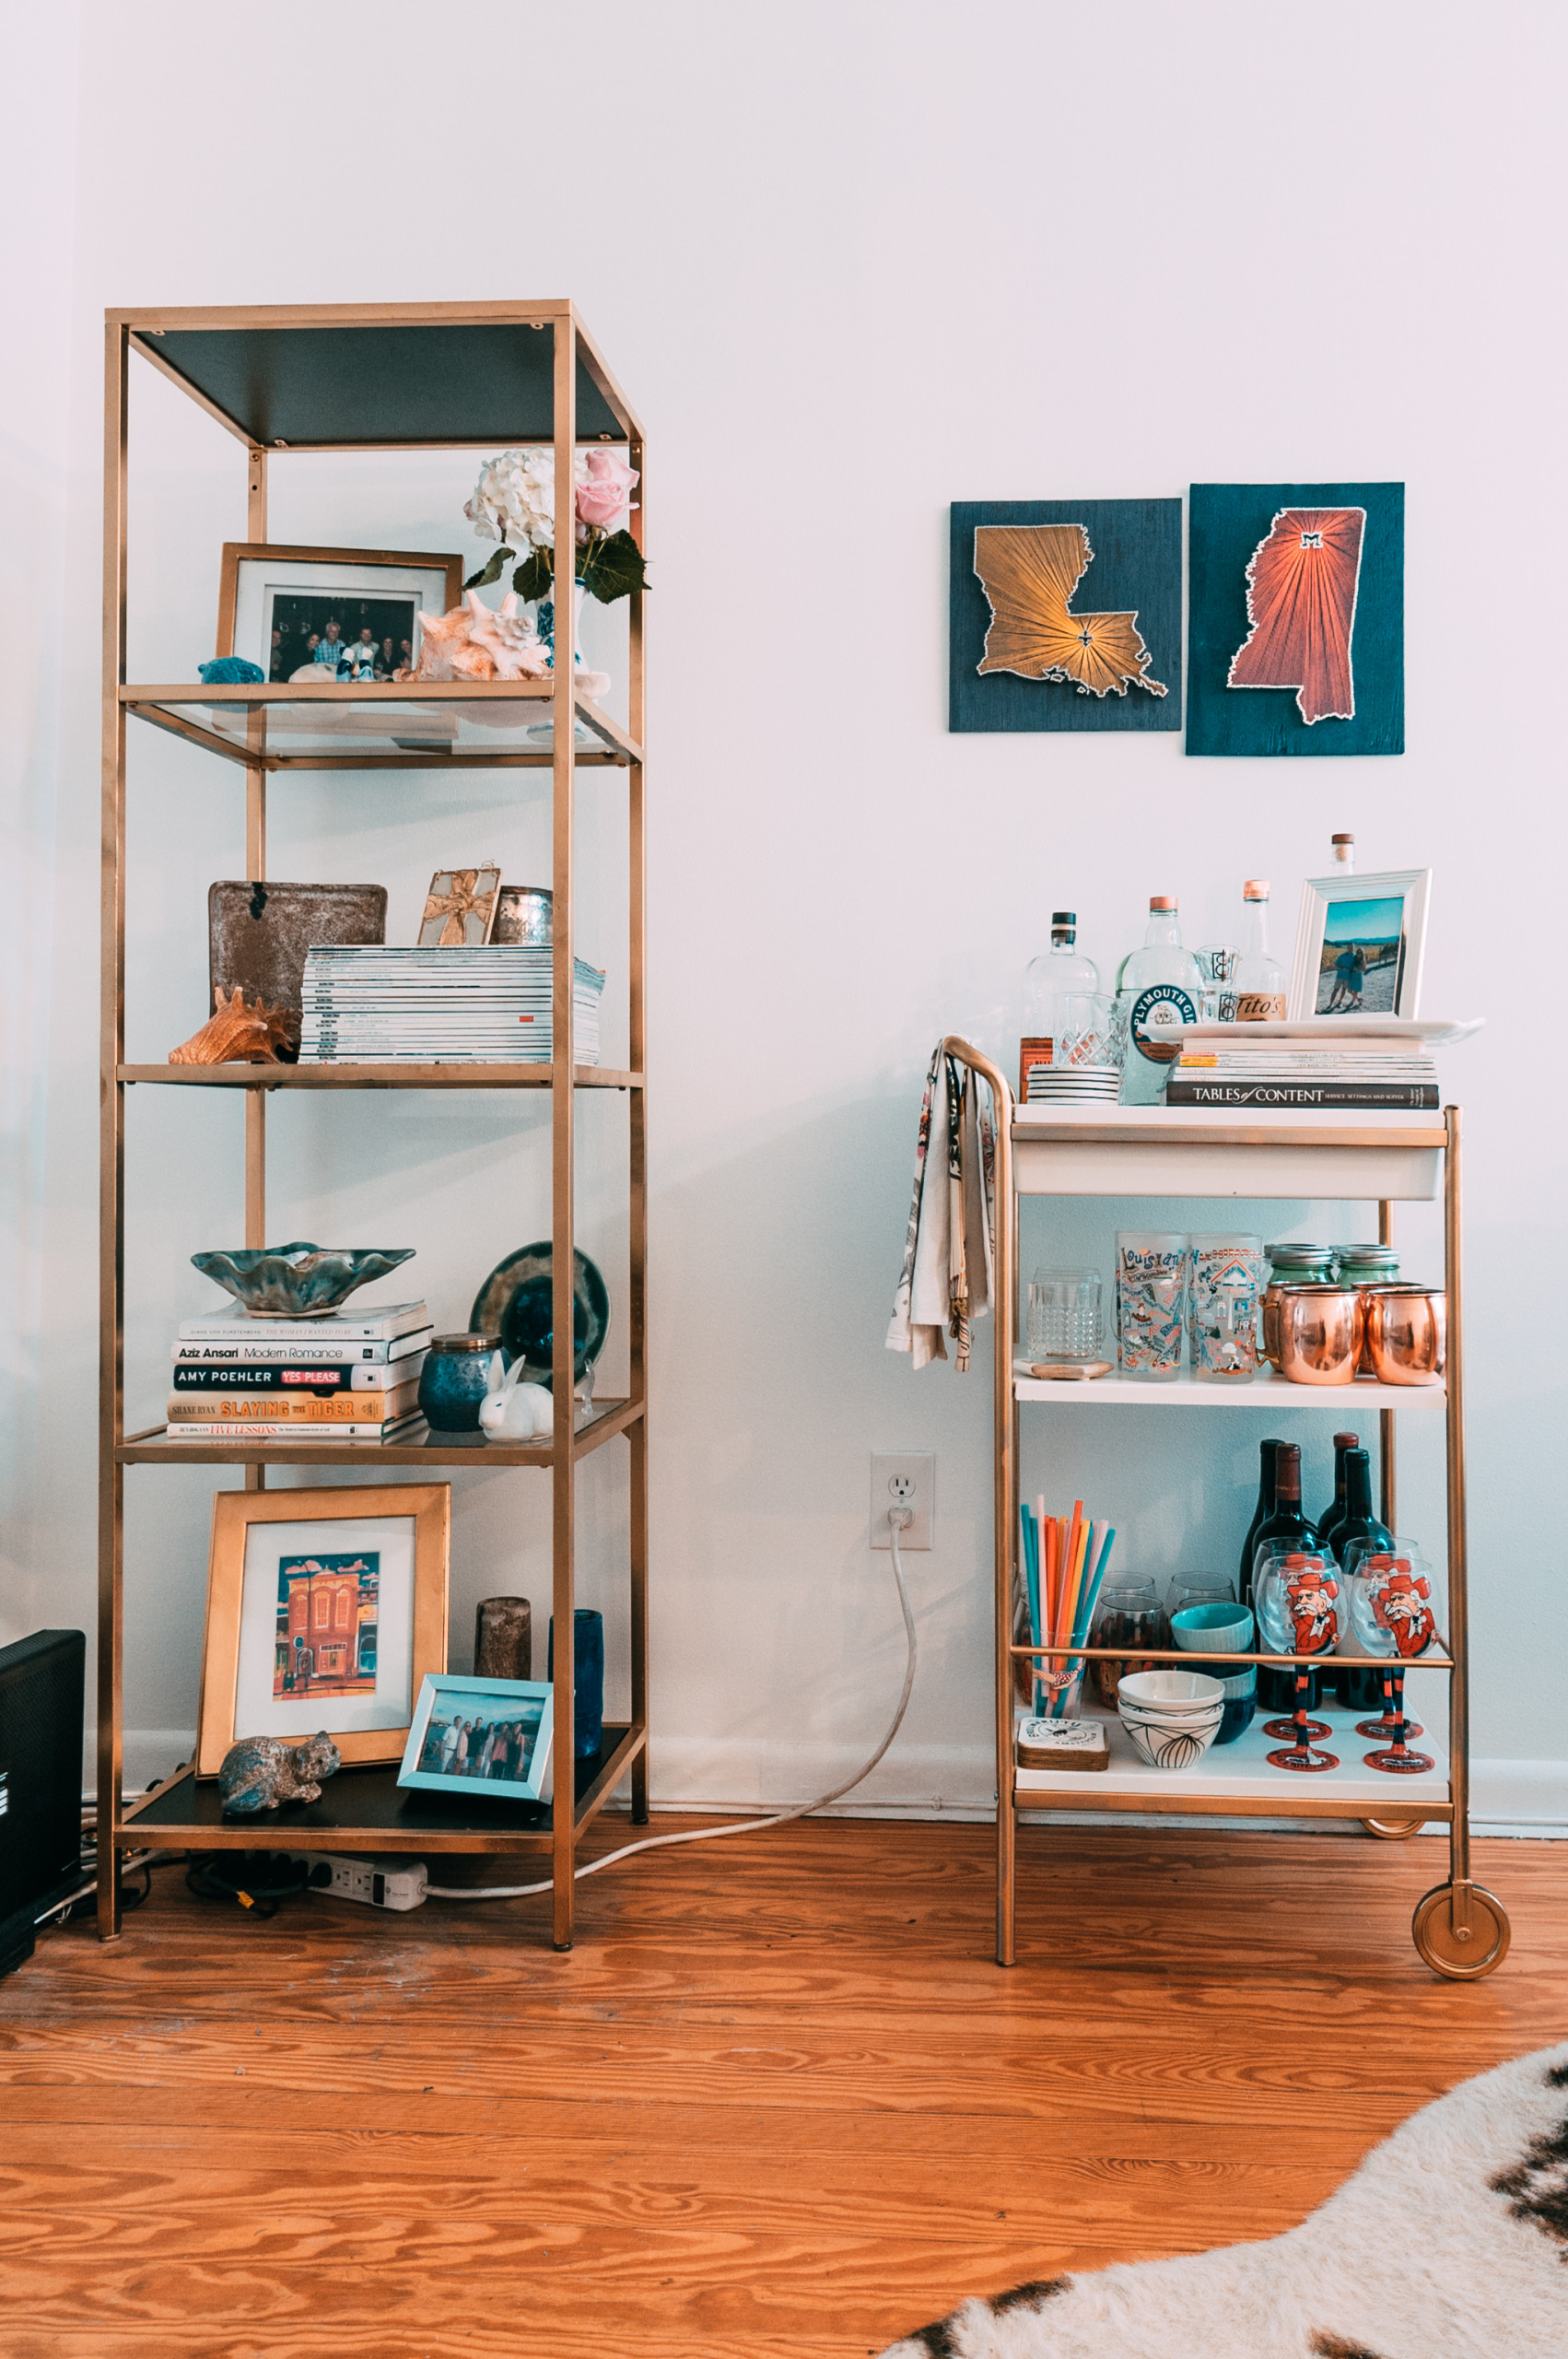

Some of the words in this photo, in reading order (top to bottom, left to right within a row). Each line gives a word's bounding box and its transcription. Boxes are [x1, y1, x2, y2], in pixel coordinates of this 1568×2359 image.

[1301, 532, 1323, 548] M
[1134, 988, 1187, 1026] PLYMOUTH
[1236, 995, 1281, 1014] Tito's
[1193, 1088, 1240, 1100] TABLES
[1233, 1086, 1263, 1104] of
[1256, 1089, 1324, 1102] CONTENT
[179, 1348, 201, 1358] Aziz
[203, 1348, 239, 1358] Ansari
[244, 1348, 287, 1358] Modern
[288, 1347, 343, 1358] Romance
[178, 1371, 207, 1381] AMY
[211, 1371, 272, 1381] POEHLER
[283, 1371, 301, 1381] YES
[304, 1371, 340, 1382] PLEASE
[172, 1406, 197, 1414] SHANE
[197, 1406, 216, 1414] RYAN
[221, 1401, 290, 1417] SLAYING
[306, 1401, 355, 1417] TIGER
[210, 1426, 234, 1435] FIVE
[235, 1426, 276, 1435] LESSONS
